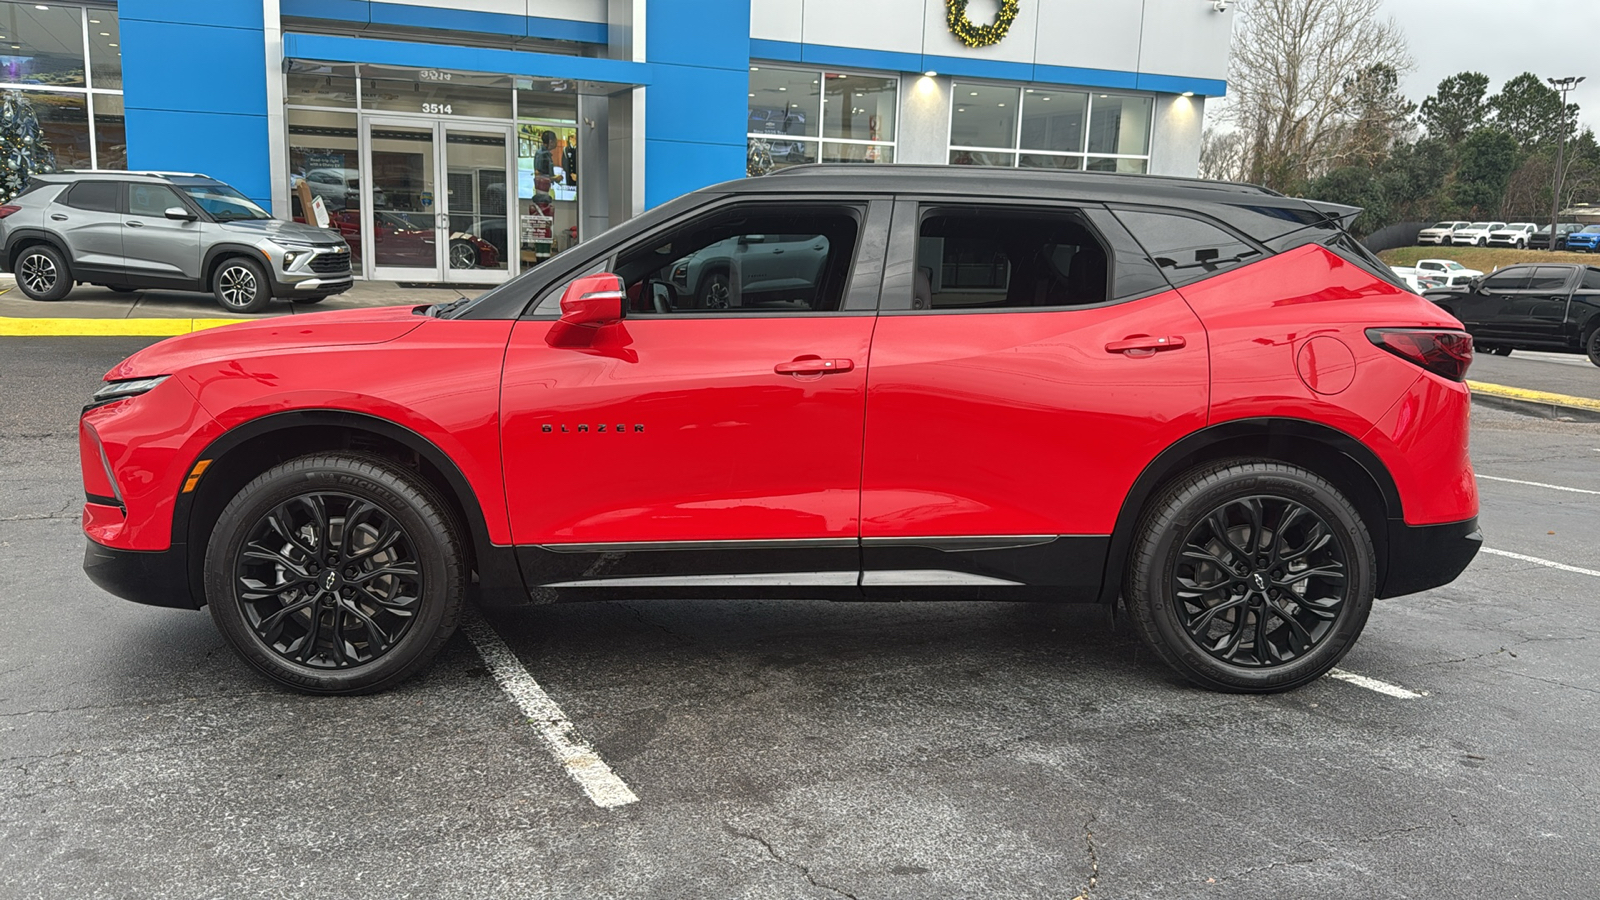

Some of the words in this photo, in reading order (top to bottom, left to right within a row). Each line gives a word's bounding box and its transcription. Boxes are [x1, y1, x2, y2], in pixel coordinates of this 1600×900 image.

[422, 102, 453, 115] 3514
[541, 423, 645, 434] BLAZER
[339, 475, 406, 510] MICHELIN
